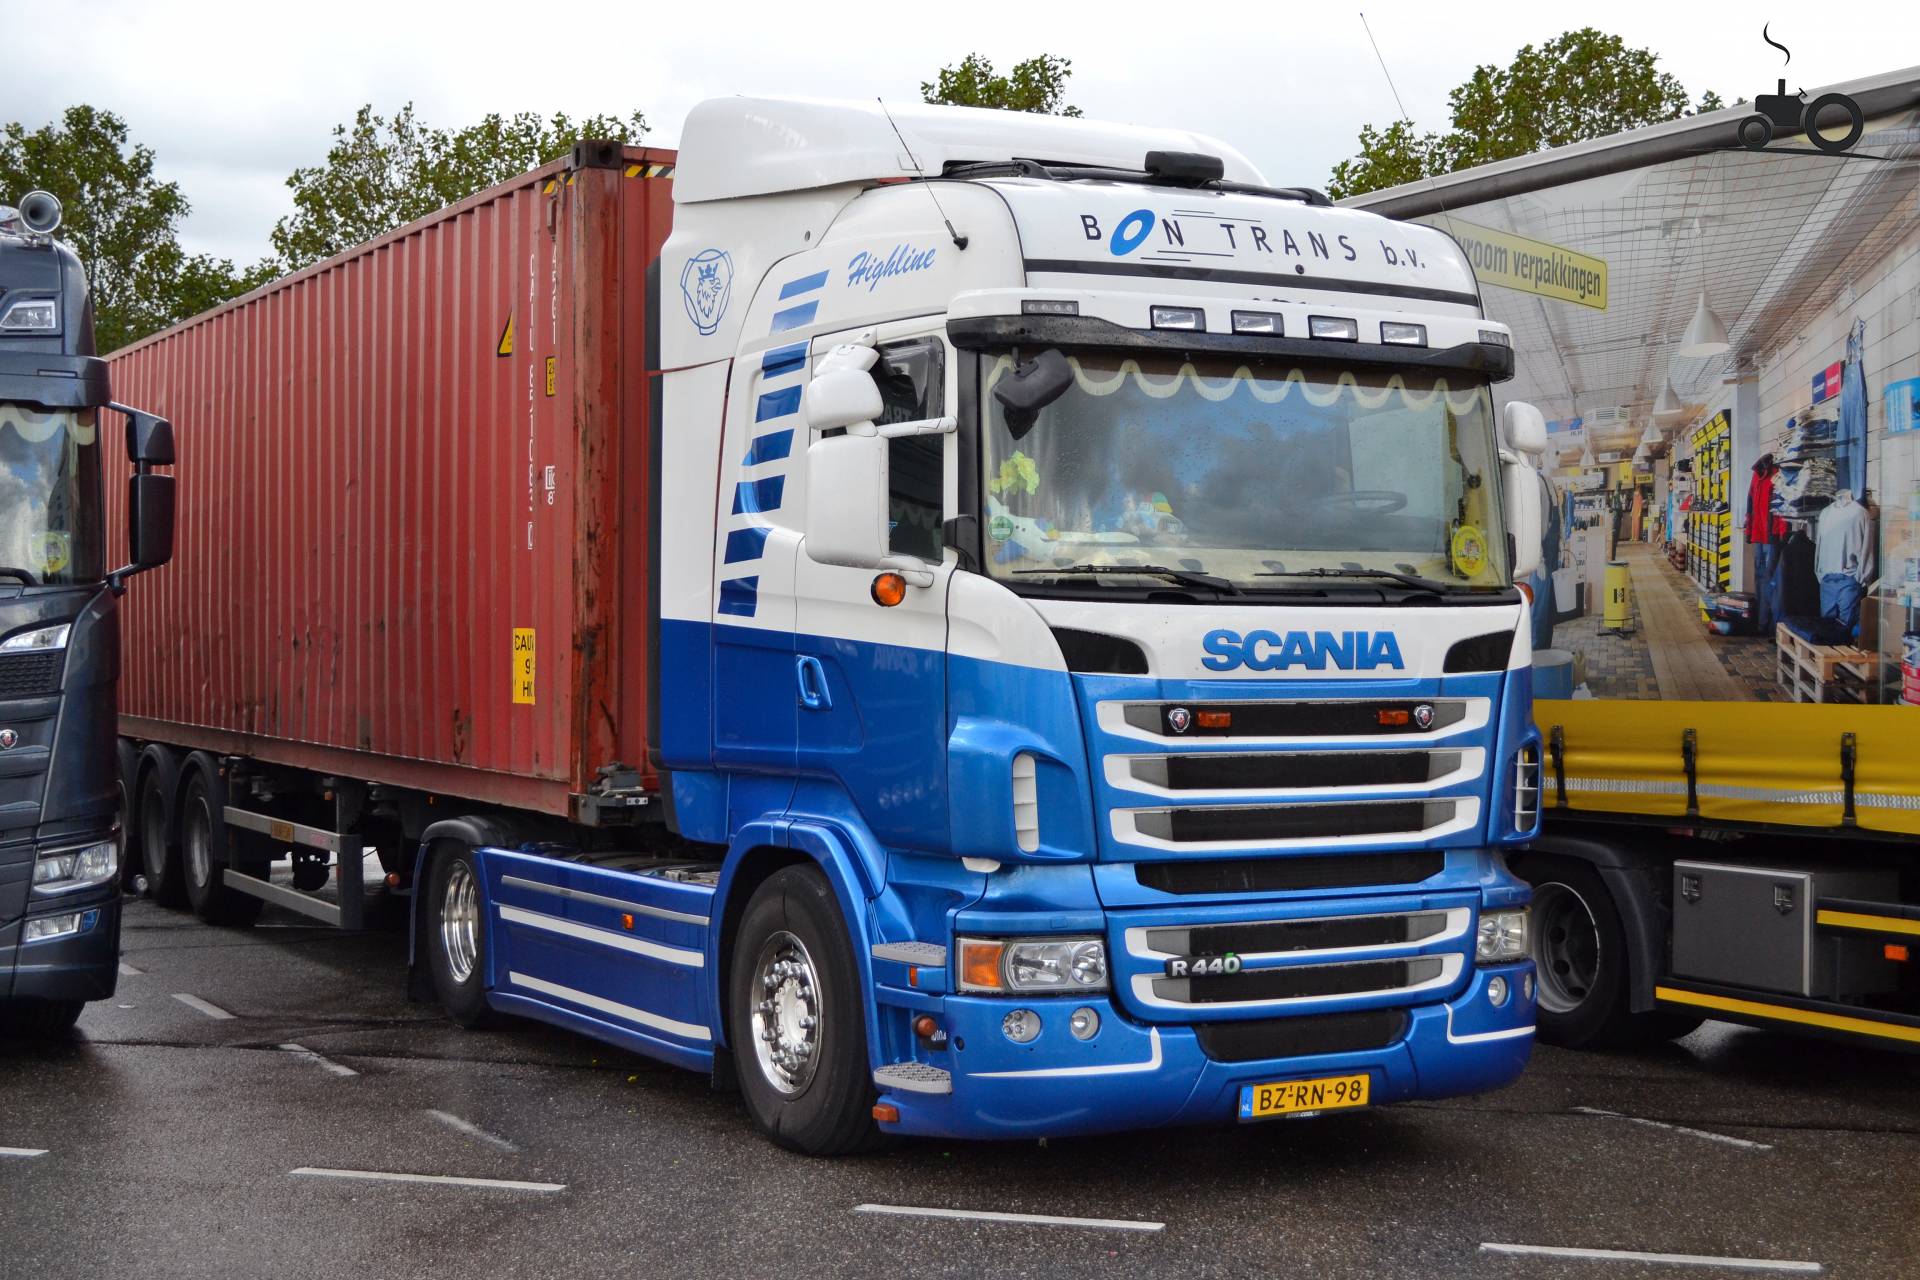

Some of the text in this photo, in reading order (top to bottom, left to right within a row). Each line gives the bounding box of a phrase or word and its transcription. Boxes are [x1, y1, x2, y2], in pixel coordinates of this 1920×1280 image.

[1080, 209, 1426, 269] BON TRANS b.v.
[847, 243, 936, 293] Highline
[1512, 251, 1601, 300] verpakkingen
[1200, 628, 1406, 672] SCANIA
[1171, 955, 1241, 976] R 440
[1241, 1104, 1251, 1112] NL
[1259, 1080, 1362, 1111] BZ-RN-98
